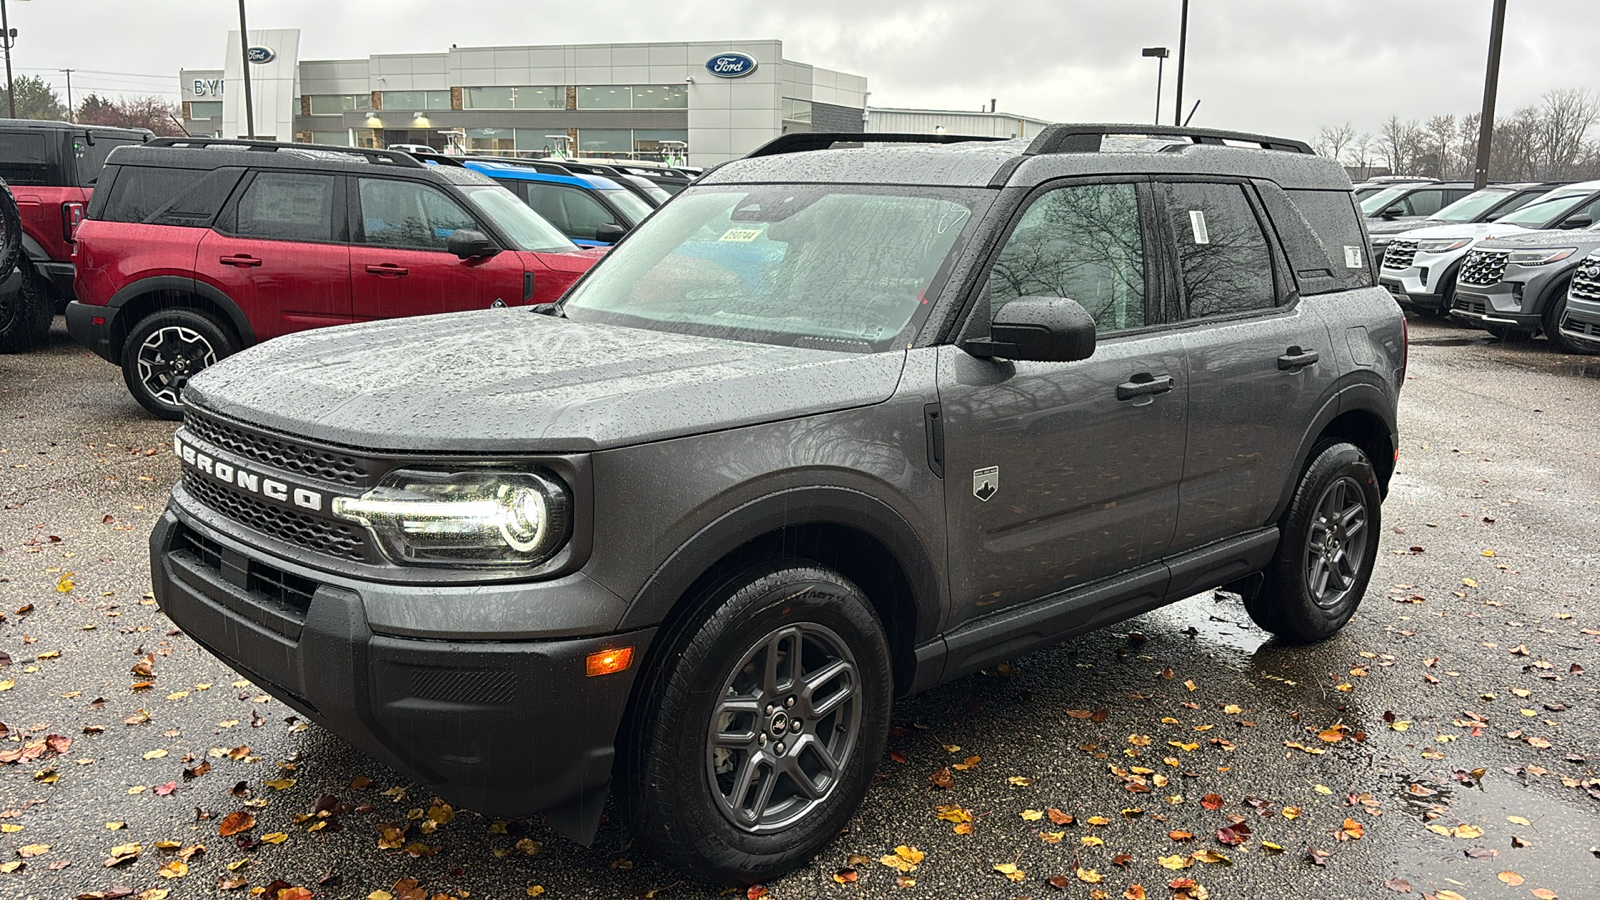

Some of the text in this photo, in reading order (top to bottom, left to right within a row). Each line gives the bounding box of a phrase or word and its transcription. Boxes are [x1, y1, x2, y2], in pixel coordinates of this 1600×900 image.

[248, 49, 265, 60] Ford
[714, 57, 744, 72] Ford
[182, 444, 322, 511] BRONCO
